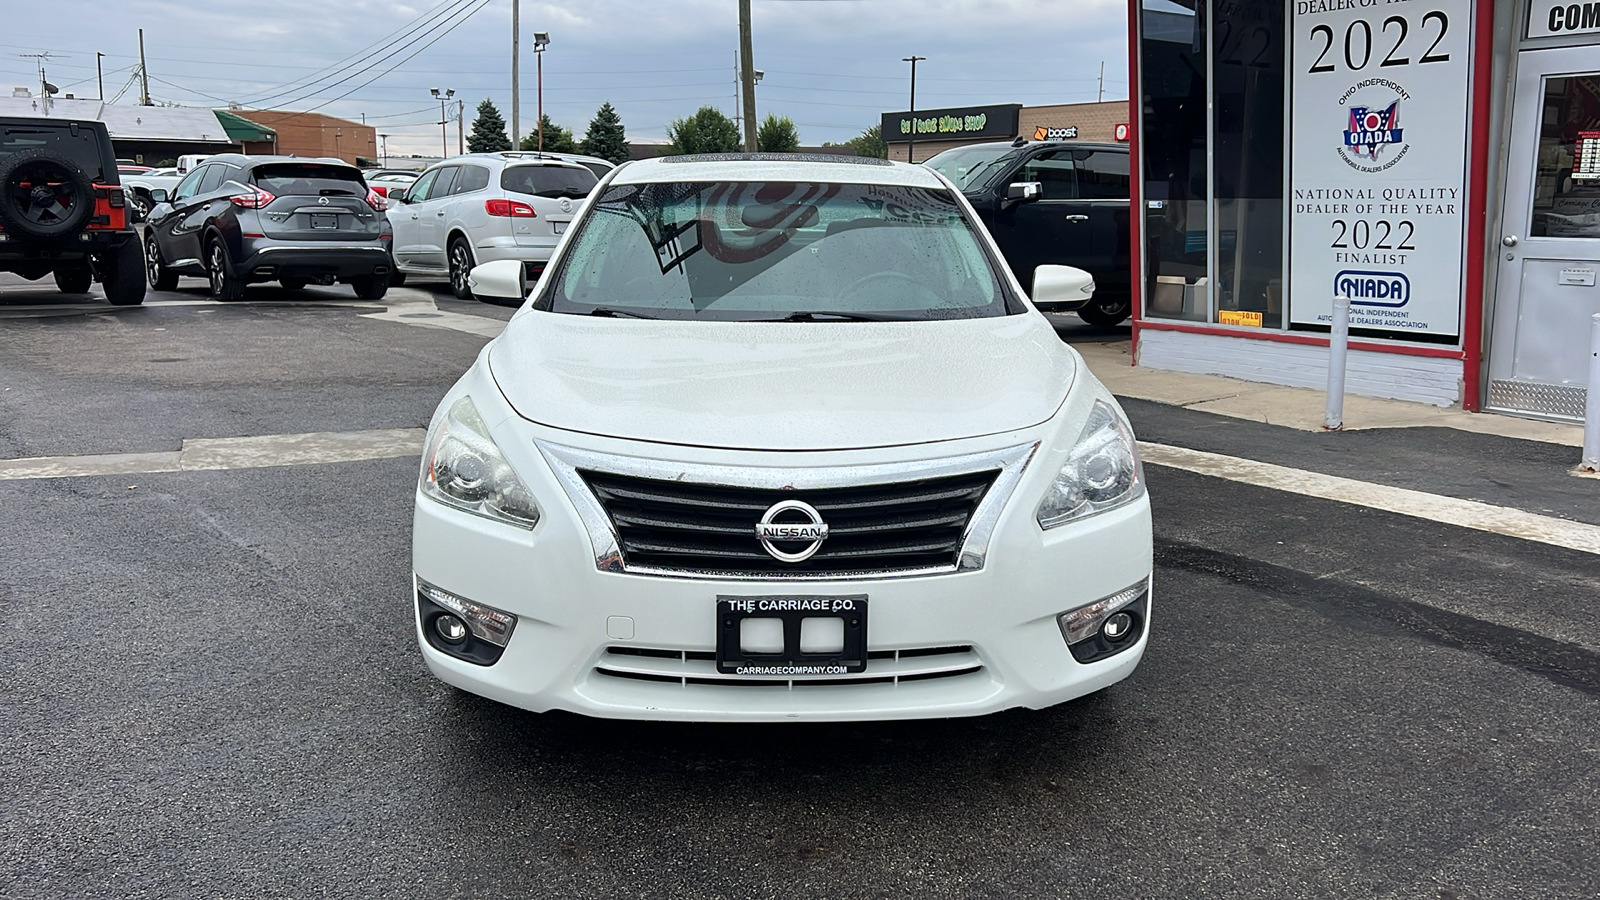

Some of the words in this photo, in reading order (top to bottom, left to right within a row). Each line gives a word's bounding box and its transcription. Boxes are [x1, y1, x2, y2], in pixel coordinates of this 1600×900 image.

[1297, 0, 1355, 15] DEALER
[1548, 3, 1600, 32] COM
[1308, 10, 1450, 74] 2022
[1338, 86, 1357, 105] OHIO
[1356, 78, 1411, 101] INDEPENDENT
[1047, 126, 1077, 138] boost
[1350, 130, 1393, 144] OIADA
[1336, 147, 1360, 171] AUTOMOBILE
[1383, 143, 1410, 170] ASSOCIATION
[1295, 188, 1375, 200] NATIONAL
[1382, 188, 1459, 201] QUALITY
[1296, 204, 1349, 214] DEALER
[1355, 204, 1374, 214] OF
[1380, 204, 1409, 214] THE
[1415, 204, 1456, 215] YEAR
[1331, 219, 1415, 251] 2022
[1335, 252, 1408, 265] FINALIST
[1340, 278, 1403, 299] NIADA
[1366, 309, 1410, 318] INDEPENDENT
[1356, 317, 1383, 326] DEALERS
[1384, 319, 1429, 329] ASSOCIATION
[763, 527, 821, 537] NISSAN
[728, 600, 756, 611] THE
[758, 599, 830, 611] CARRIAGE
[833, 599, 856, 611] CO.
[736, 666, 848, 674] CARRIAGECOMPANY.COM
